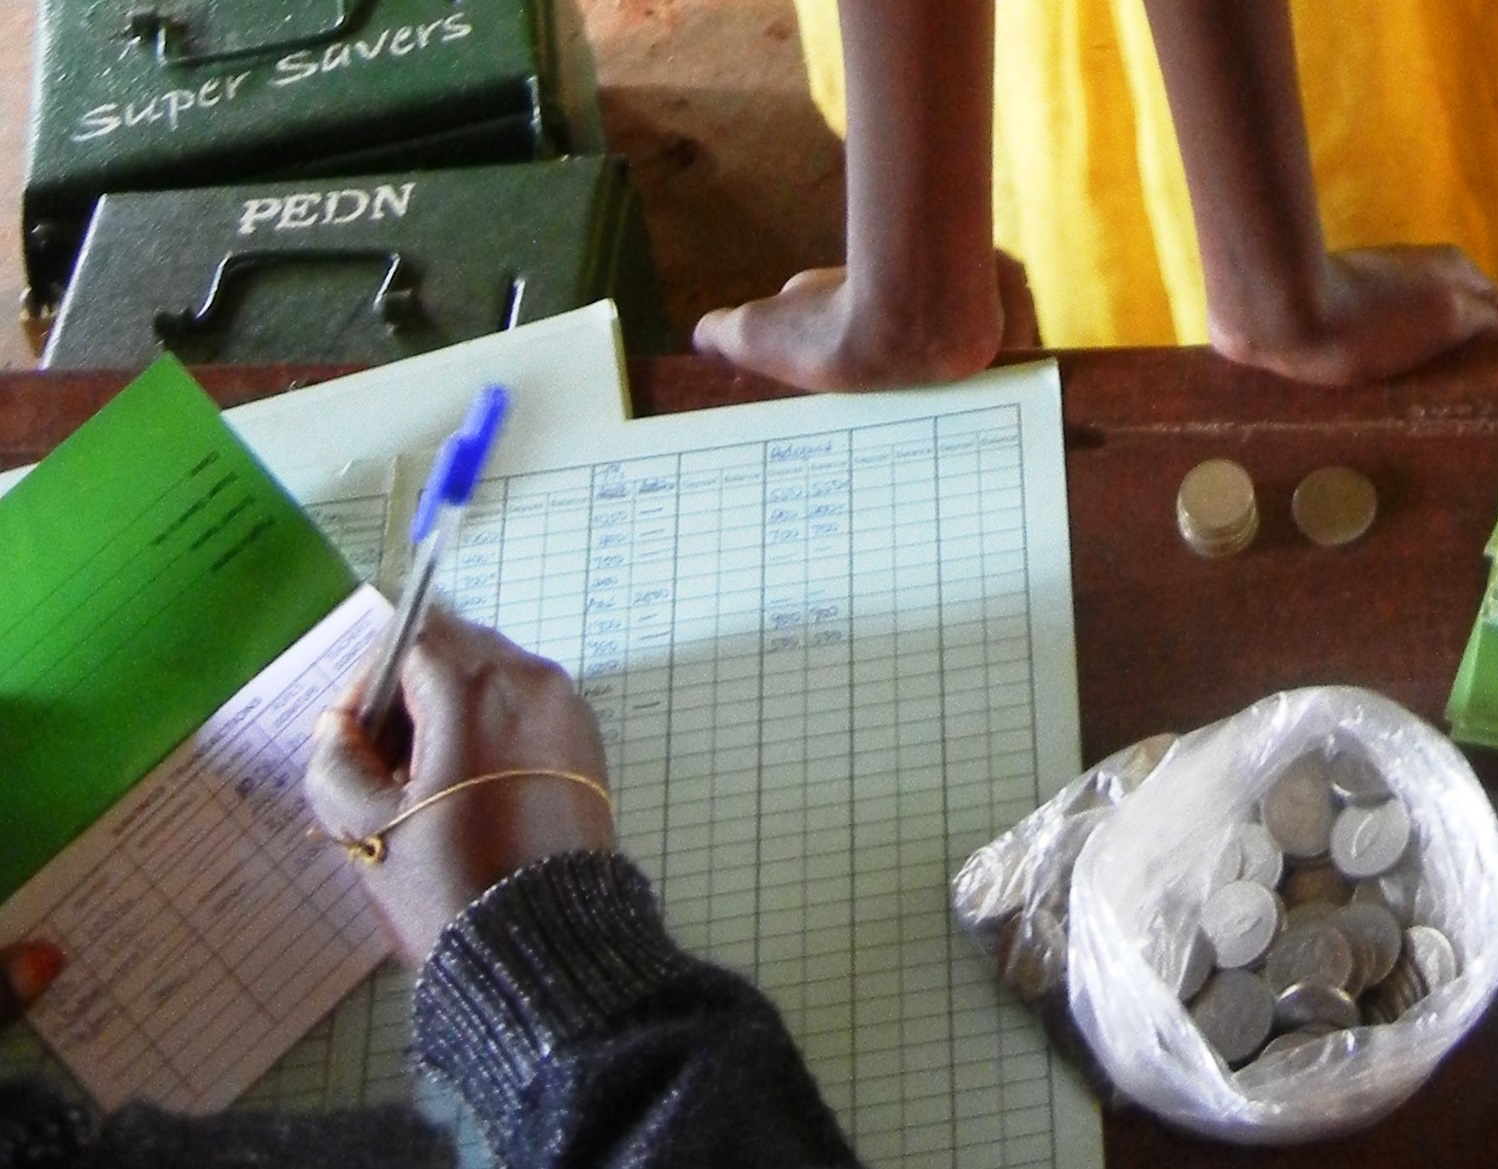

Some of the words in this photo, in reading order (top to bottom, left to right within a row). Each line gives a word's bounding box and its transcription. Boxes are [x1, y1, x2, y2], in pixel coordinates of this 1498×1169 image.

[71, 71, 243, 142] Super
[268, 11, 474, 87] Savers
[239, 183, 418, 235] PEDN
